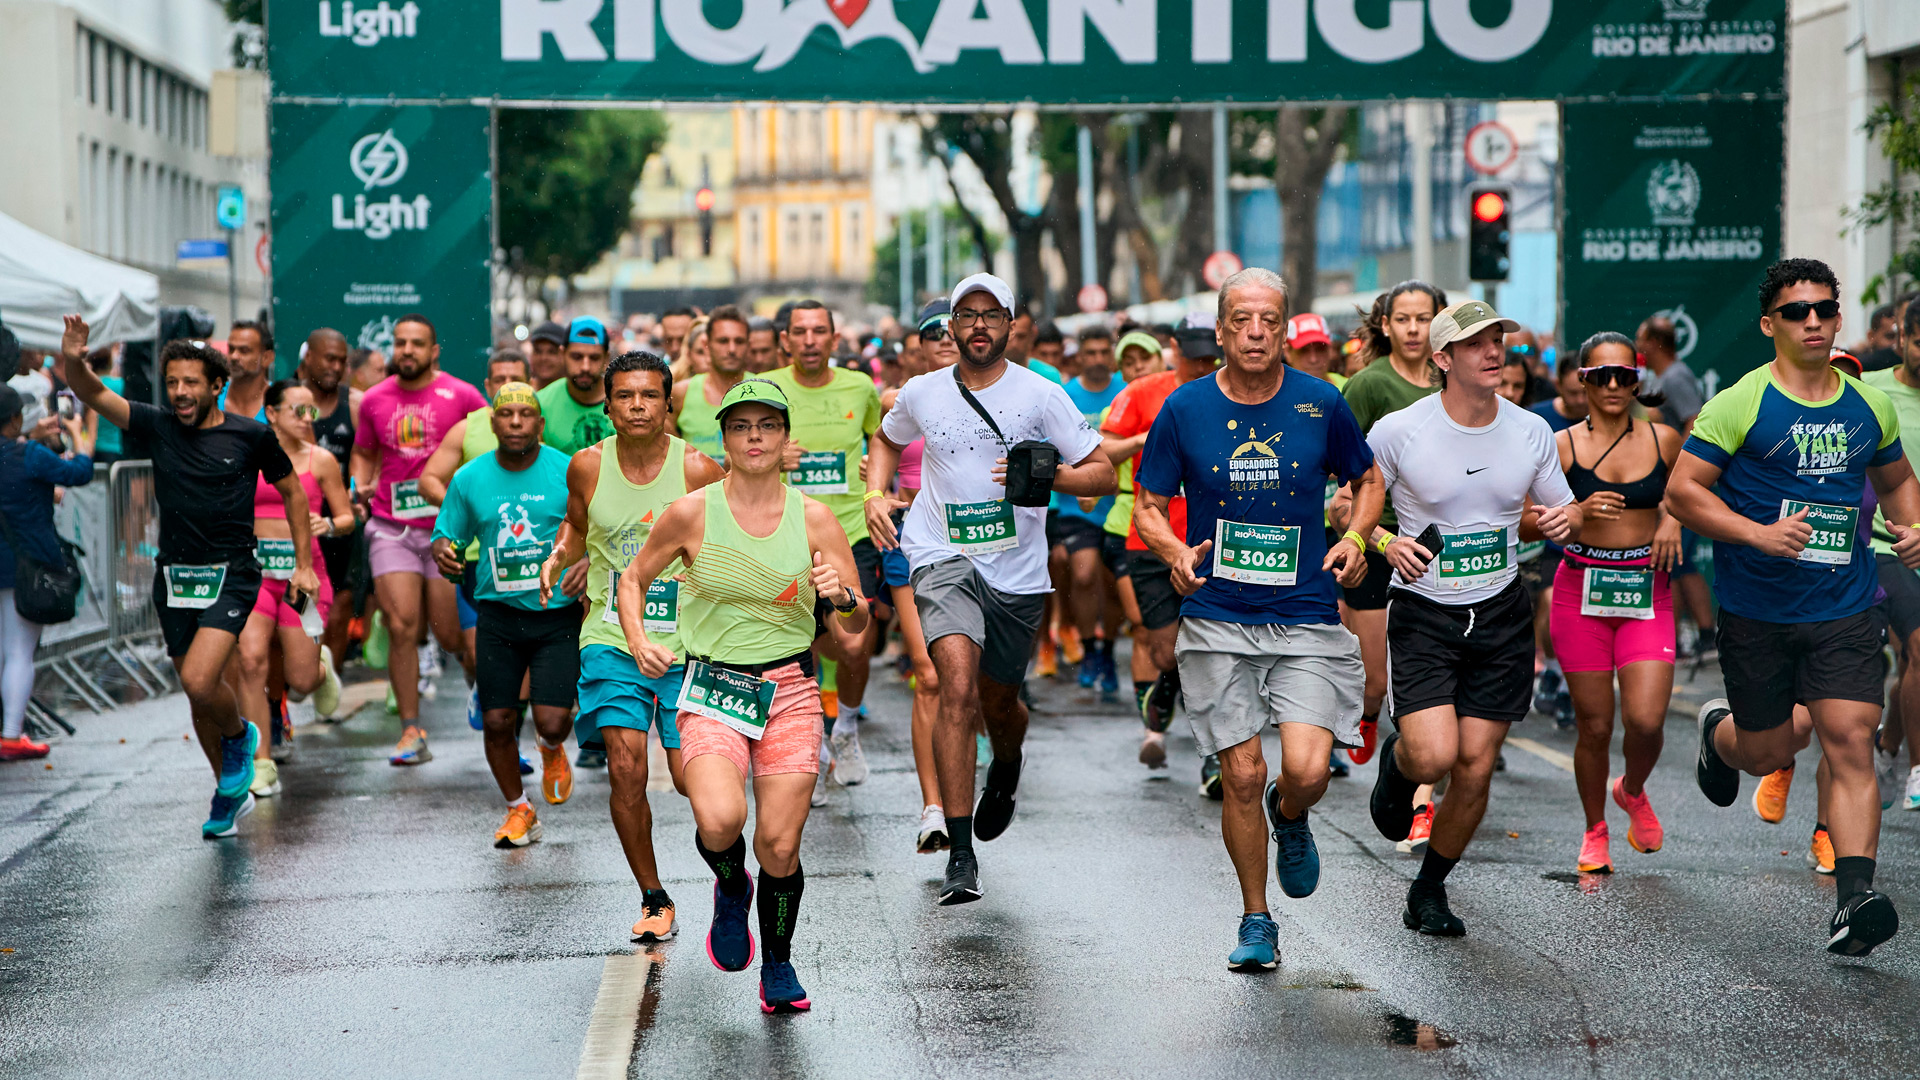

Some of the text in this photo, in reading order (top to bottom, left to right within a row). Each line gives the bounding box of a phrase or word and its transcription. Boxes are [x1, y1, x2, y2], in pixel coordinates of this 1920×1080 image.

[318, 0, 420, 46] Light
[1592, 20, 1776, 36] GOVERNO DO ESTADO
[500, 0, 783, 66] RIO
[1592, 33, 1776, 57] RIO DE JANEIRO
[331, 193, 432, 240] Light
[1582, 226, 1764, 240] GOVERNO DO ESTADO
[1582, 238, 1763, 262] RIO DE JANEIRO
[1792, 423, 1846, 435] SE CUIDAR
[1792, 432, 1848, 454] VALE
[1229, 458, 1279, 470] EDUCADORES
[1797, 451, 1849, 468] A PENA
[806, 469, 841, 482] 3634
[1229, 468, 1279, 482] VÃO ALÉM DA
[1229, 480, 1280, 491] SALA DE AULA
[528, 494, 545, 502] Light
[955, 505, 1002, 517] RIO ANTIGO
[1820, 513, 1849, 521] ANTIGO
[621, 528, 637, 541] SE
[966, 521, 1006, 540] 3195
[1234, 530, 1287, 542] RIO ANTIGO
[1472, 536, 1499, 546] ANTIGO
[1808, 529, 1847, 548] 3315
[1239, 549, 1289, 568] 3062
[1586, 547, 1622, 559] NIKE
[1623, 545, 1652, 559] PRO
[268, 555, 296, 569] 302
[1443, 561, 1453, 569] 10K
[1460, 553, 1502, 573] 3032
[520, 562, 539, 577] 49
[193, 584, 210, 597] 80
[1612, 591, 1643, 605] 339
[645, 601, 668, 617] 05
[708, 689, 757, 720] 3644
